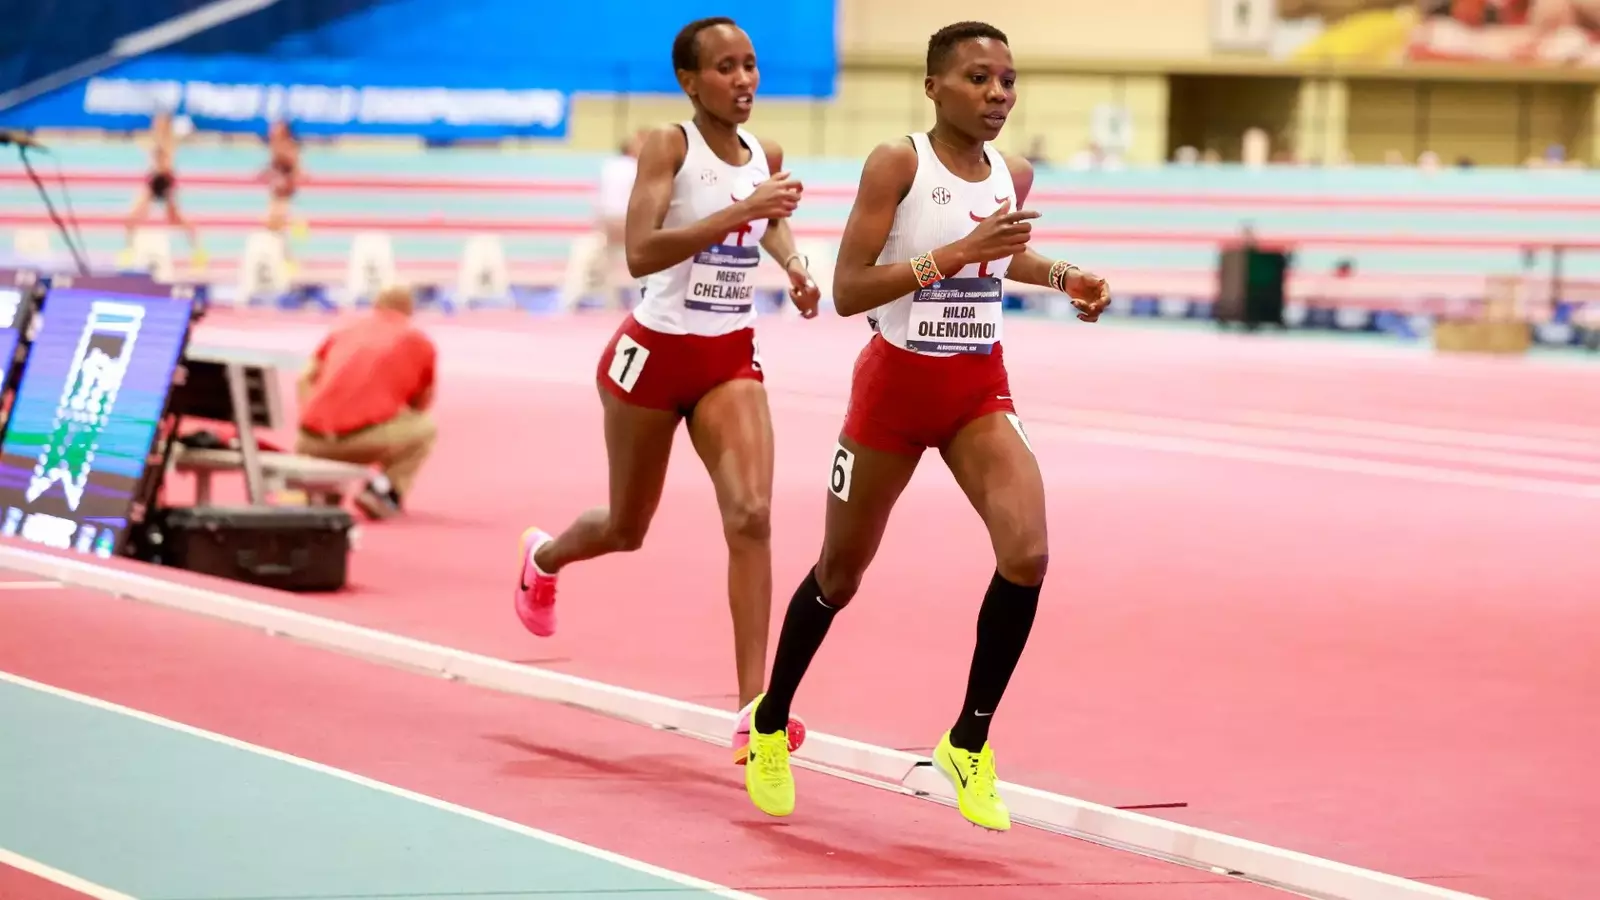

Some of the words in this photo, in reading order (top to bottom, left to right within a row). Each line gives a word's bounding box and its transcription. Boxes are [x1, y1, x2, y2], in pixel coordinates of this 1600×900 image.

[932, 187, 951, 205] SEC
[716, 270, 746, 283] MERCY
[693, 282, 752, 299] CHELANGA
[943, 306, 976, 319] HILDA
[918, 321, 996, 339] OLEMOMOI
[619, 346, 638, 384] 1
[831, 449, 848, 494] 6
